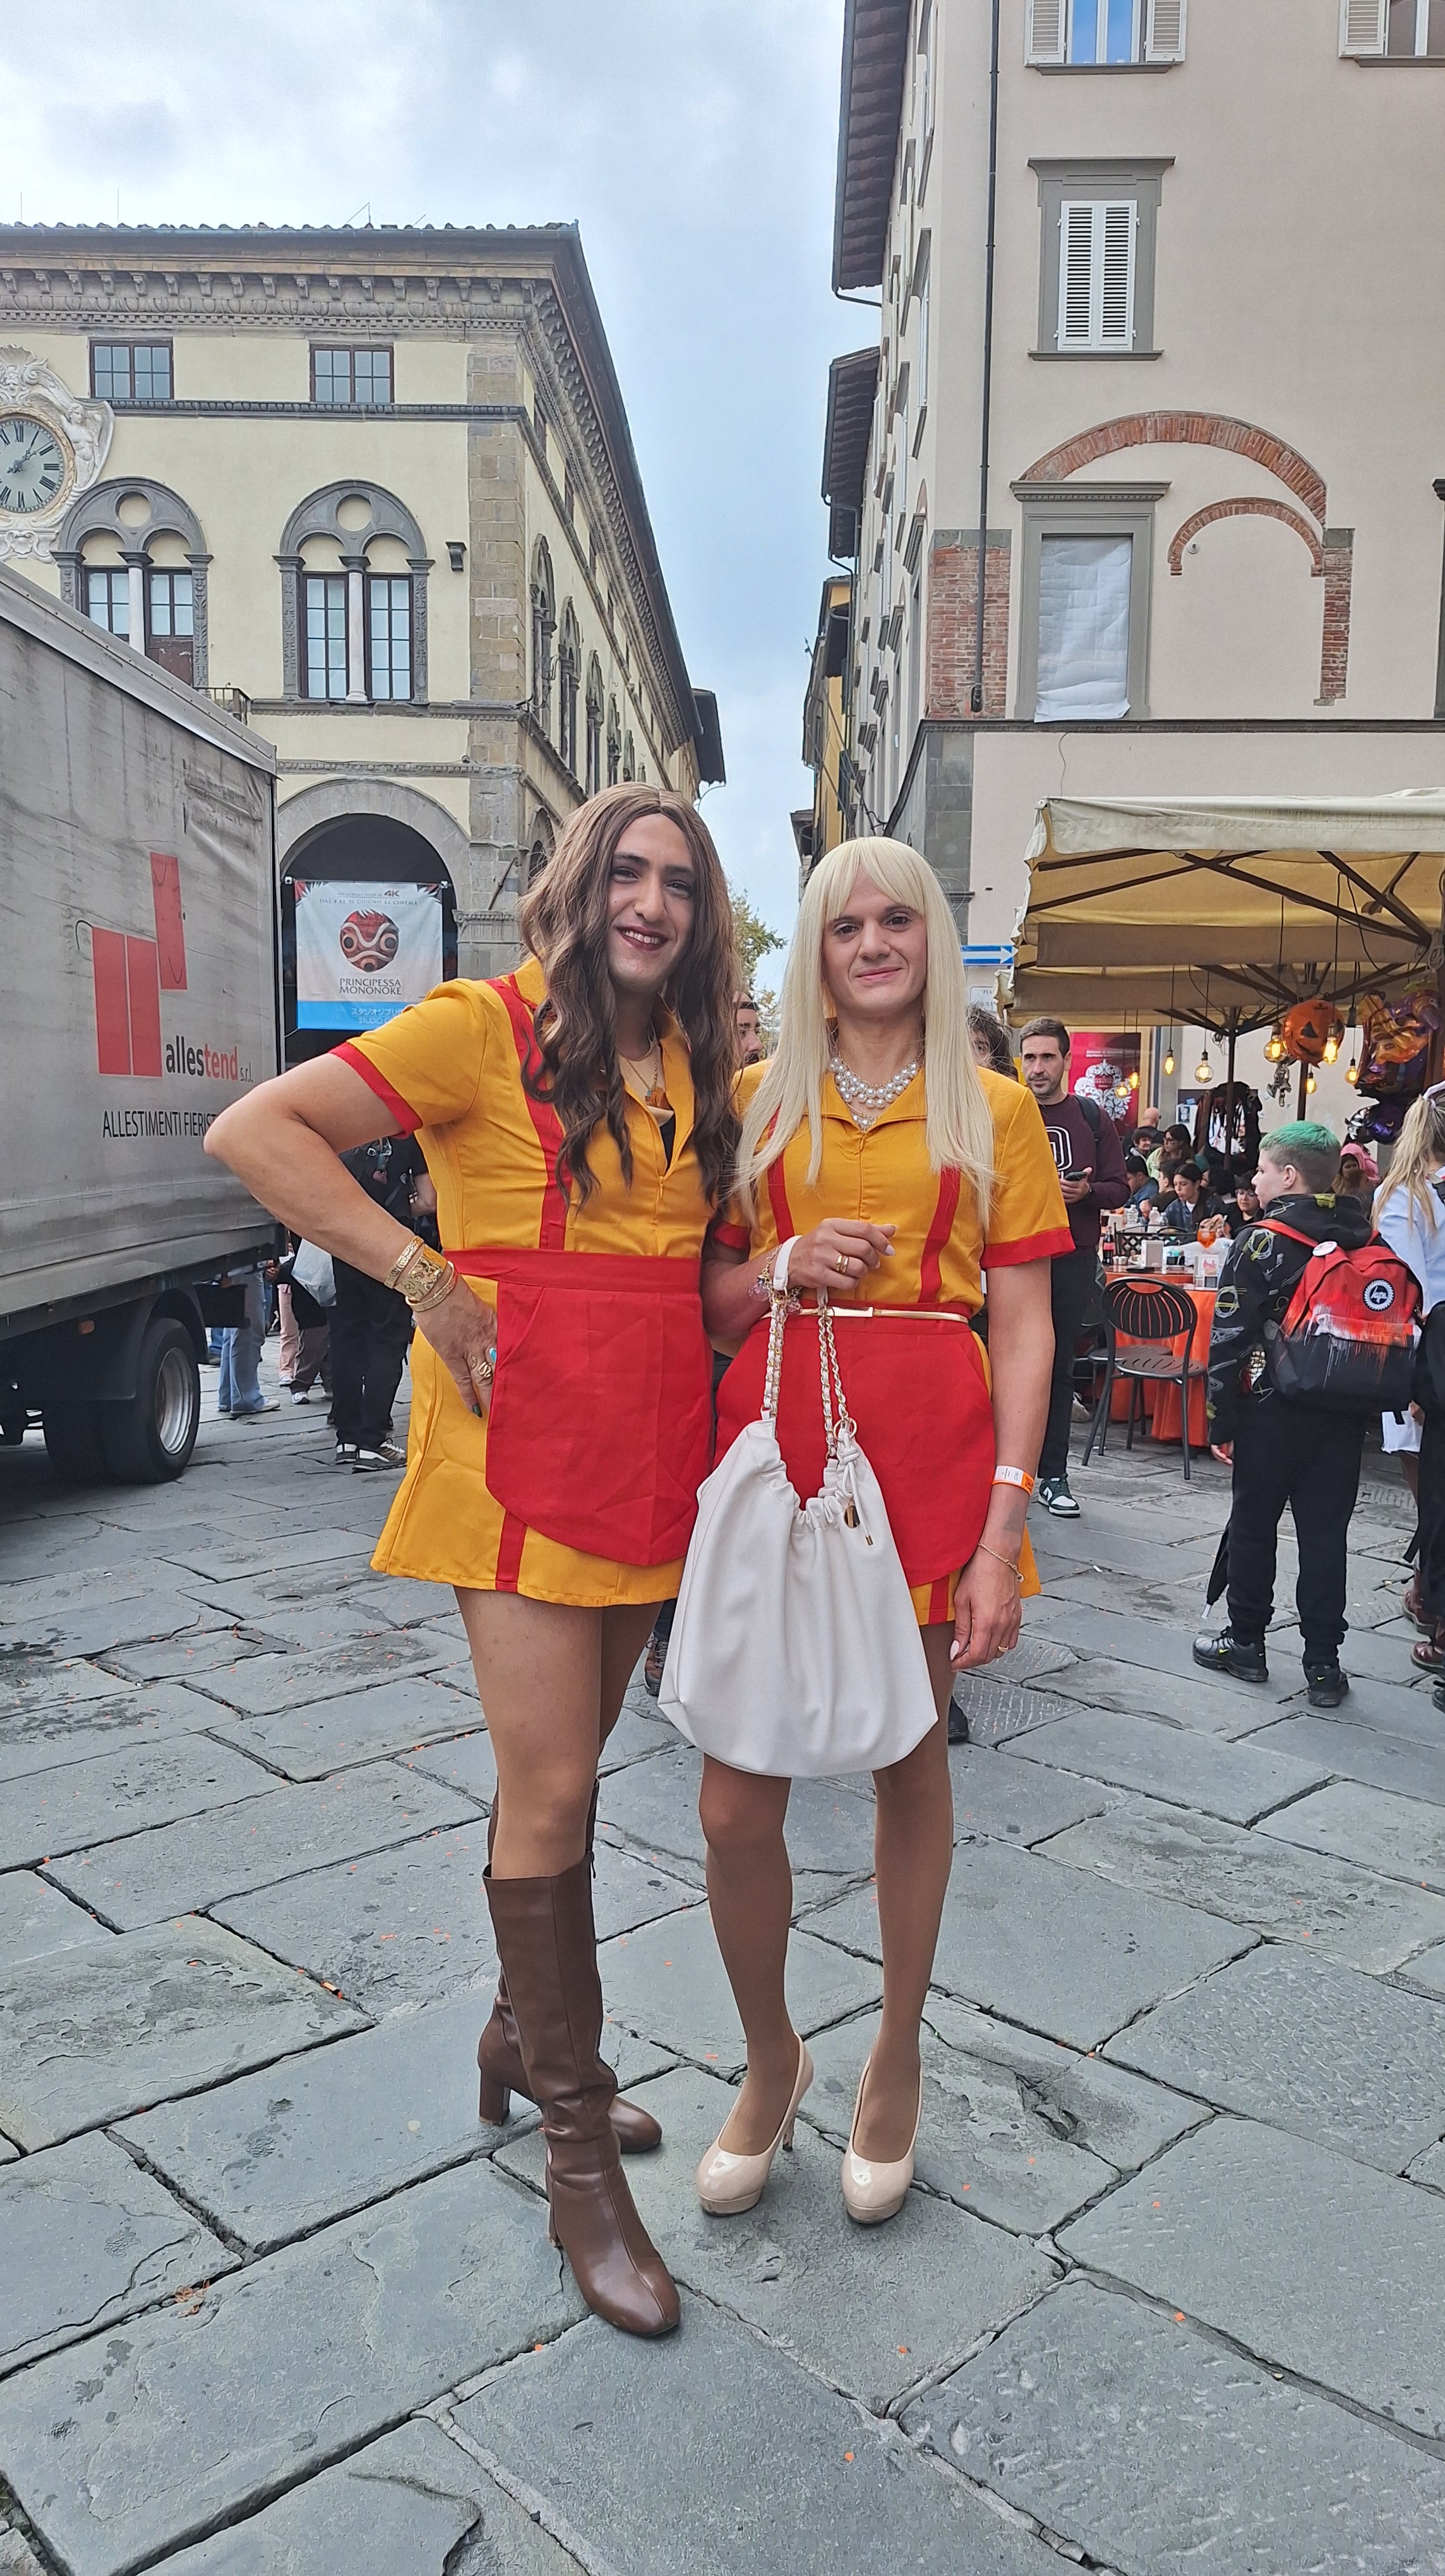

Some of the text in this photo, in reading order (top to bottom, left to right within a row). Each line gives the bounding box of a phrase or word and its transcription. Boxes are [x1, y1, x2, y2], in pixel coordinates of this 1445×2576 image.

[340, 978, 401, 987] PRINCIPESSA
[339, 986, 402, 995] MONONOKE
[351, 1008, 402, 1016] スタジオジブリ
[166, 1035, 254, 1083] allestend s.r.l.
[102, 1111, 182, 1138] ALLESTIMENTI
